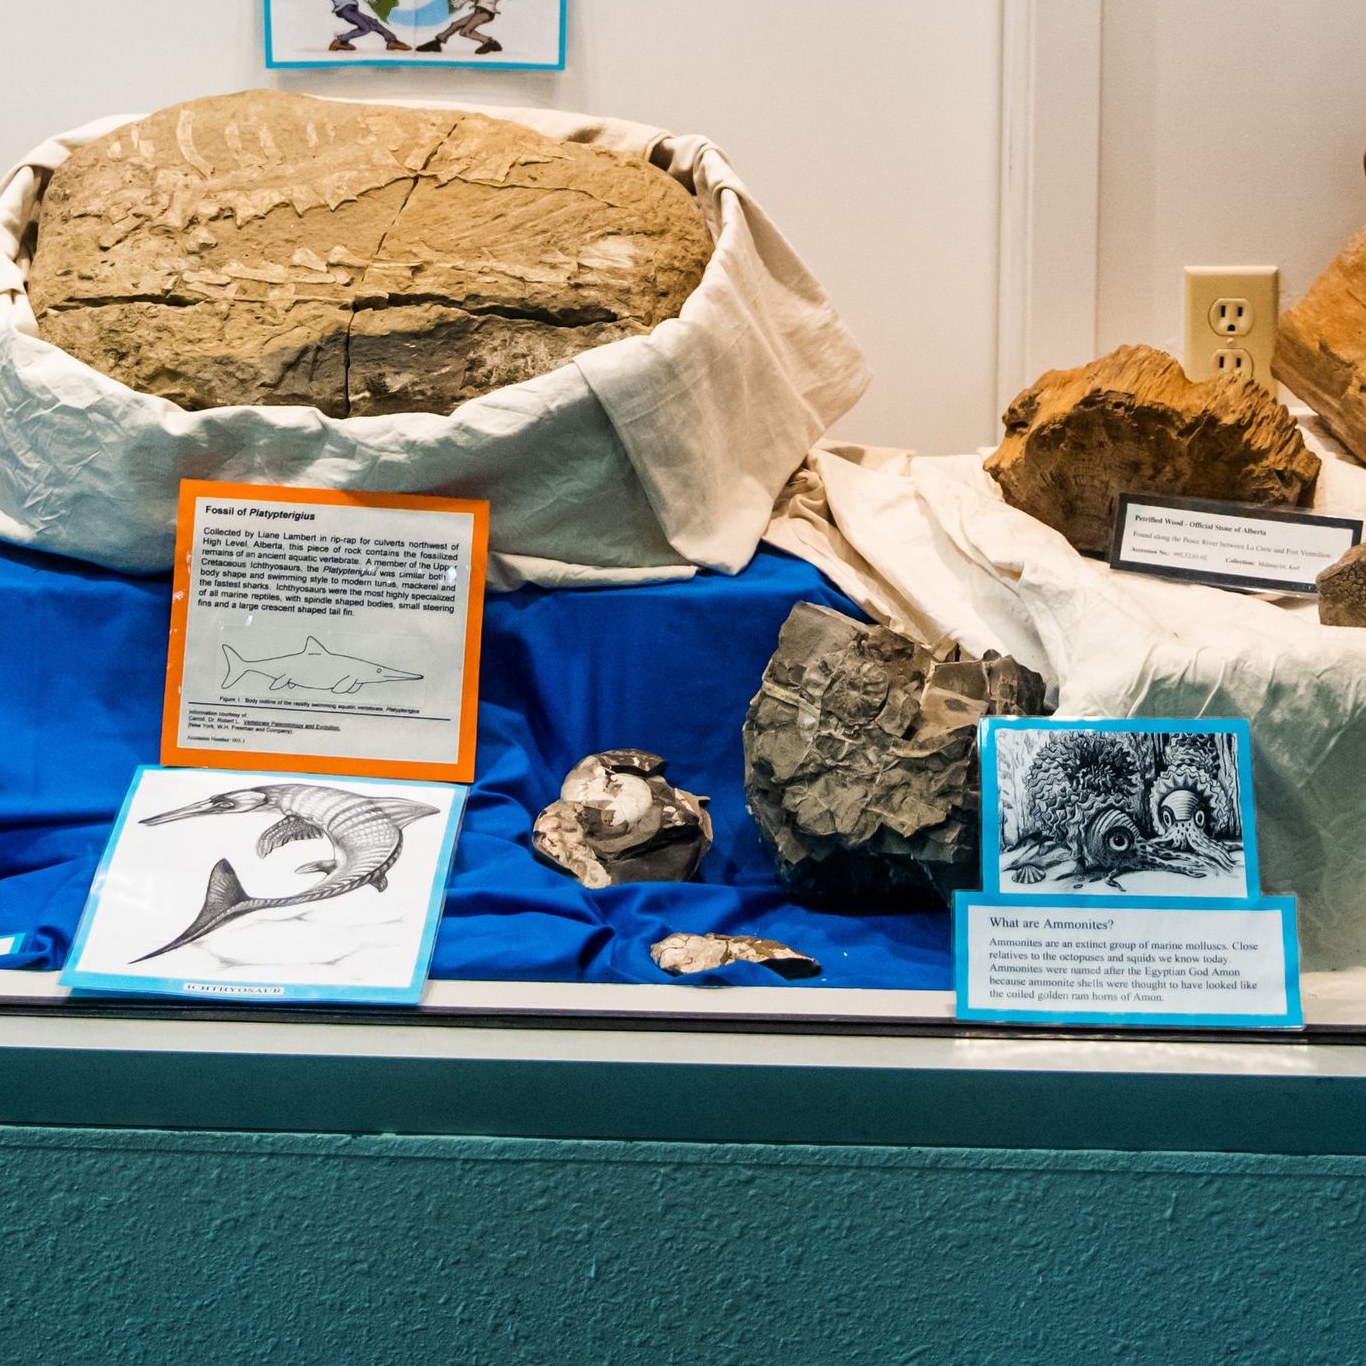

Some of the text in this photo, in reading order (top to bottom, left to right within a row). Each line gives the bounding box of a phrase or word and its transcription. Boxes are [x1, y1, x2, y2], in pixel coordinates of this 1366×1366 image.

[205, 505, 234, 515] Fossil
[236, 507, 247, 515] of
[203, 526, 241, 536] Collected
[244, 529, 254, 539] by
[257, 530, 279, 539] Liane
[283, 532, 316, 541] Lambert
[330, 536, 356, 544] rip-rap
[359, 536, 370, 545] for
[373, 538, 405, 547] culverts
[408, 541, 447, 550] northwest
[450, 542, 459, 550] of
[989, 916, 1114, 929] What are Ammonites?
[989, 937, 1042, 947] Ammonites
[1075, 940, 1106, 948] extinct
[1109, 942, 1136, 951] group
[1138, 940, 1149, 949] of
[1185, 941, 1228, 950] molluscs.
[1231, 941, 1258, 950] Close
